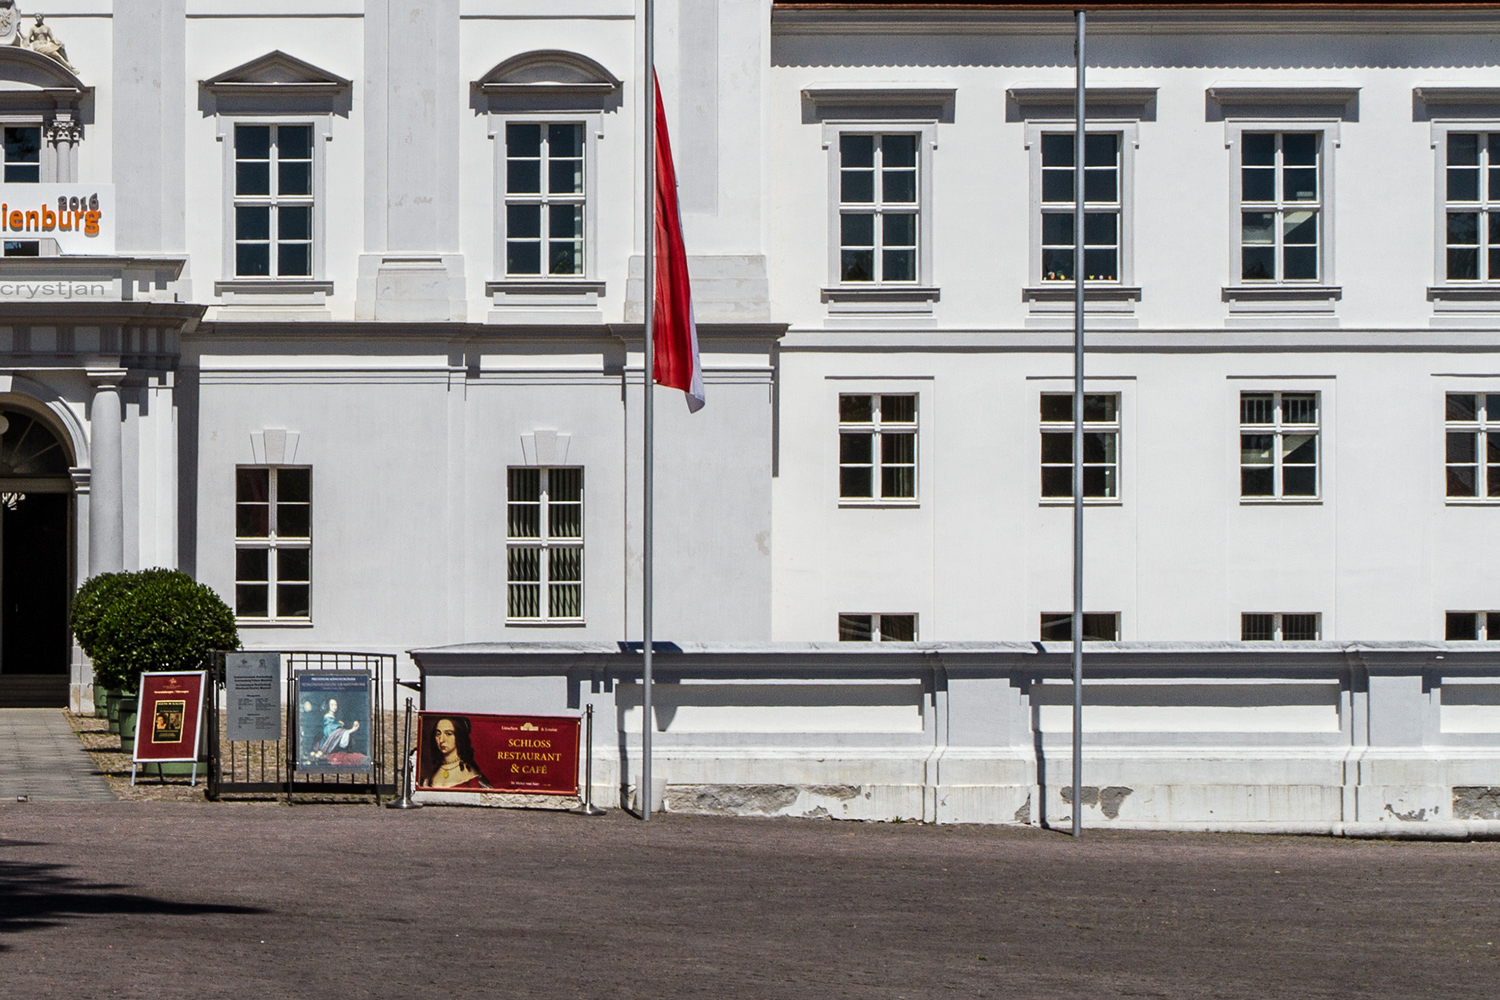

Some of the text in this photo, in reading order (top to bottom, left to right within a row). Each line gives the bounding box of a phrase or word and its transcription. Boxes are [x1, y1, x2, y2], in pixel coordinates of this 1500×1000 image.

[508, 738, 552, 748] SCHLOSS
[497, 751, 562, 762] RESTAURANT
[510, 763, 520, 774] &
